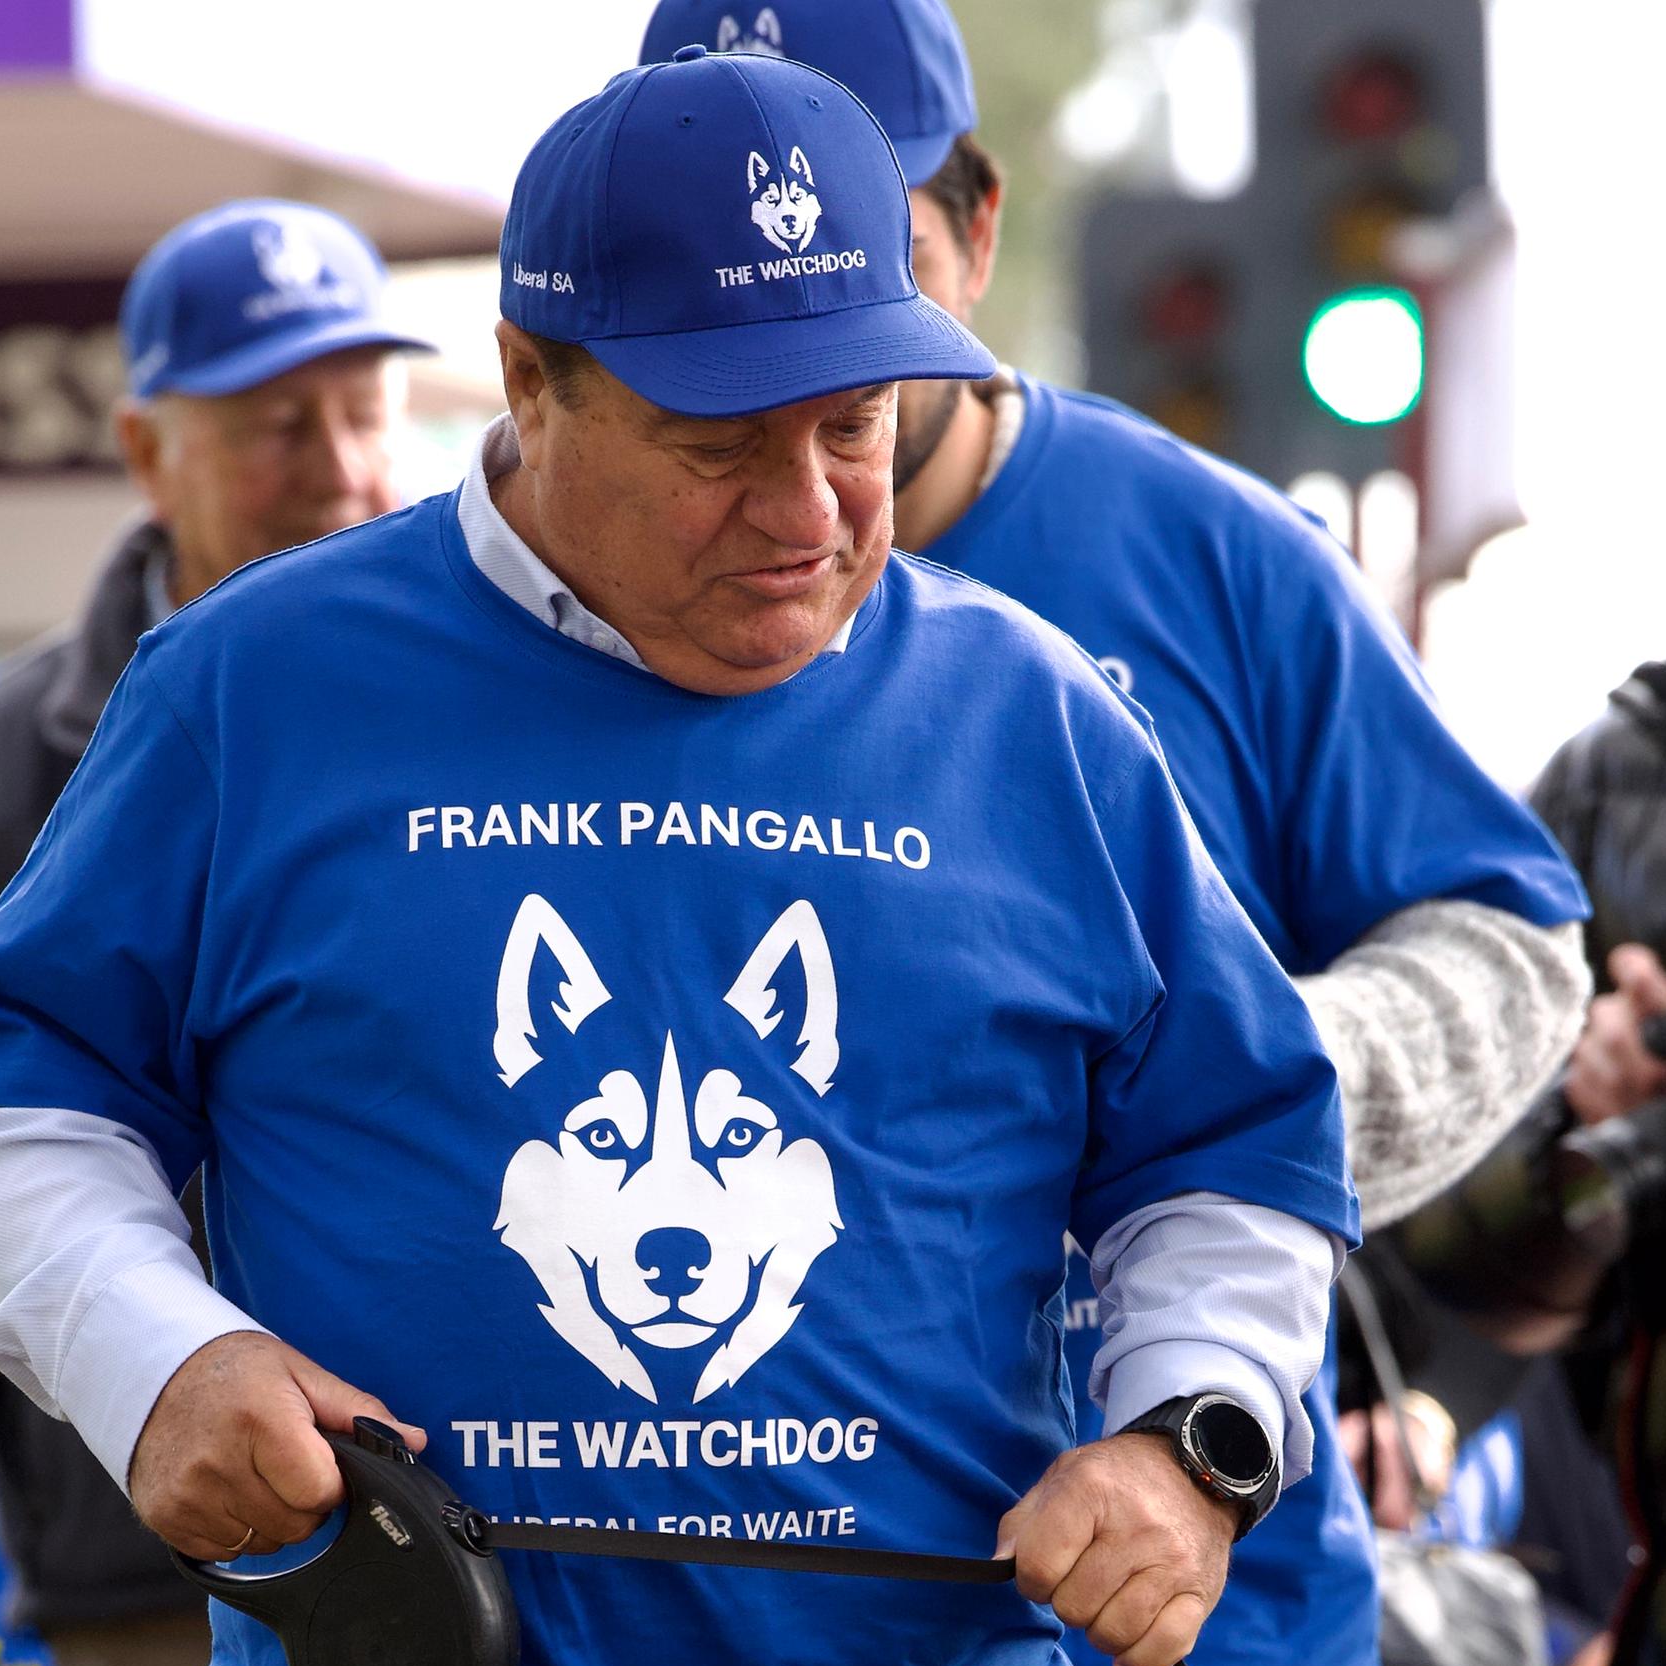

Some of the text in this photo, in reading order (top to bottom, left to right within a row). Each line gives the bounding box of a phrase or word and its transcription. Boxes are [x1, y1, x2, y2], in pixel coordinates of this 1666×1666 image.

[552, 272, 575, 294] SA
[715, 249, 866, 288] THE WATCHDOG
[408, 801, 931, 870] FRANK PANGALLO
[451, 1417, 879, 1468] THE WATCHDOG
[370, 1505, 410, 1546] flexi
[658, 1514, 732, 1539] FOR
[742, 1506, 856, 1541] WAITE
